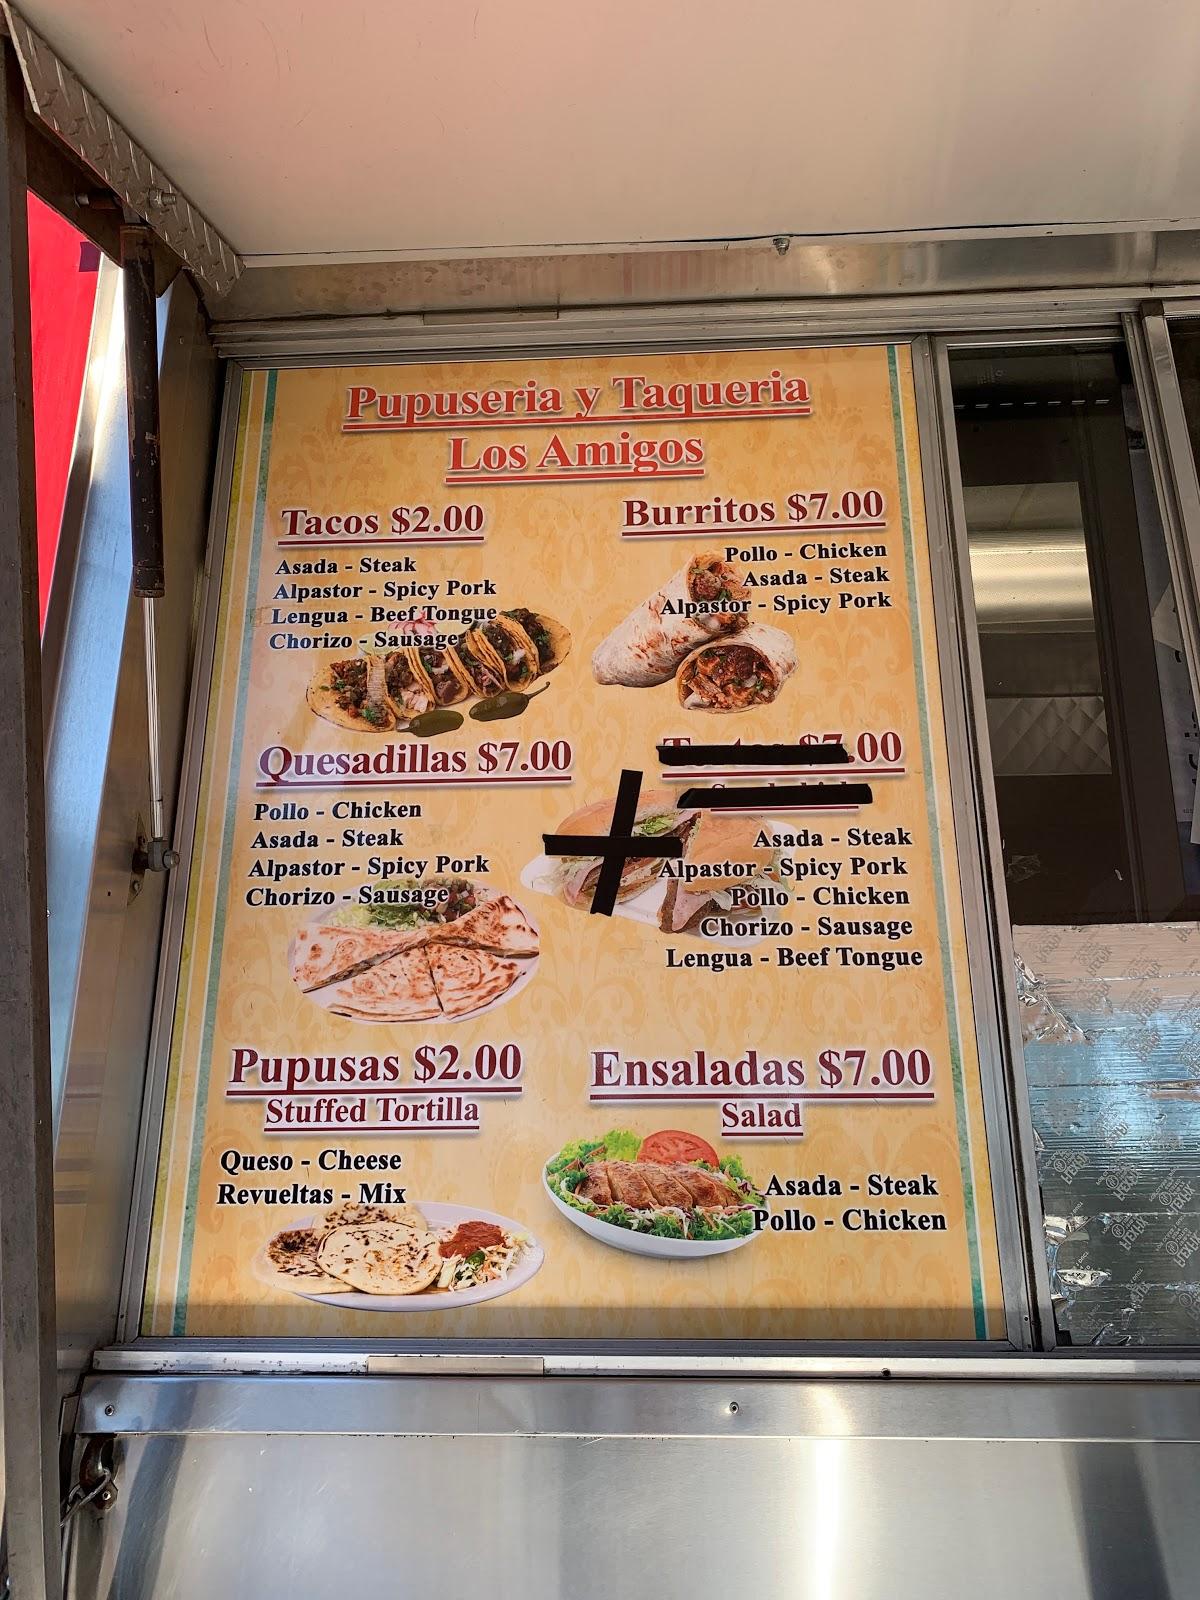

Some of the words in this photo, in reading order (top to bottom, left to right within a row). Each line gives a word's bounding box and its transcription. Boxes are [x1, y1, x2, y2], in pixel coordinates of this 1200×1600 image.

[345, 380, 563, 425] Pupuseria
[575, 386, 601, 418] y
[612, 370, 810, 416] Taqueria
[447, 436, 527, 472] Los
[538, 431, 705, 473] Amigos
[280, 508, 379, 537] Tacos
[390, 504, 485, 535] $2.00
[622, 496, 776, 528] Burritos
[787, 490, 884, 523] $7.00
[724, 546, 778, 564] Pollo
[799, 542, 887, 560] Chicken
[274, 558, 338, 575] Asada
[358, 556, 417, 574] Steak
[742, 570, 808, 587] Asada
[829, 566, 890, 584] Steak
[272, 584, 364, 603] Alpastor
[383, 580, 440, 601] Spicy
[446, 579, 497, 597] Pork
[661, 598, 752, 617] Alpastor
[773, 594, 831, 615] Spicy
[838, 592, 892, 609] Pork
[271, 608, 349, 628] Lengua
[370, 606, 417, 623] Beef
[422, 606, 497, 625] Tongue
[269, 632, 353, 651] Chorizo
[373, 631, 459, 651] Sausage
[258, 743, 467, 783] Quesadillas
[477, 739, 572, 775] $7.00
[253, 802, 309, 821] Pollo
[331, 801, 422, 820] Chicken
[250, 830, 319, 849] Asada
[341, 828, 404, 848] Steak
[753, 830, 824, 848] Asada
[846, 827, 913, 846] Steak
[247, 857, 346, 881] Alpastor
[367, 856, 428, 878] Spicy
[435, 854, 490, 874] Pork
[658, 859, 757, 882] Alpastor
[779, 857, 842, 881] Spicy
[850, 856, 908, 875] Pork
[245, 886, 335, 907] Chorizo
[358, 885, 449, 907] Sausage
[731, 888, 789, 907] Pollo
[812, 886, 910, 906] Chicken
[700, 916, 794, 937] Chorizo
[817, 916, 914, 940] Sausage
[665, 948, 753, 972] Lengua
[776, 947, 830, 968] Beef
[836, 947, 924, 972] Tongue
[228, 1048, 400, 1092] Pupusas
[413, 1043, 522, 1082] $2.00
[589, 1050, 805, 1088] Ensaladas
[818, 1048, 931, 1088] $7.00
[266, 1098, 366, 1124] Stuffed
[376, 1096, 480, 1122] Tortilla
[721, 1102, 803, 1129] Salad
[220, 1150, 294, 1175] Queso
[318, 1148, 402, 1170] Cheese
[216, 1183, 334, 1205] Revueltas
[357, 1182, 407, 1204] Mix
[764, 1175, 842, 1197] Asada
[867, 1174, 939, 1196] Steak
[752, 1209, 816, 1232] Pollo
[841, 1208, 947, 1232] Chicken
